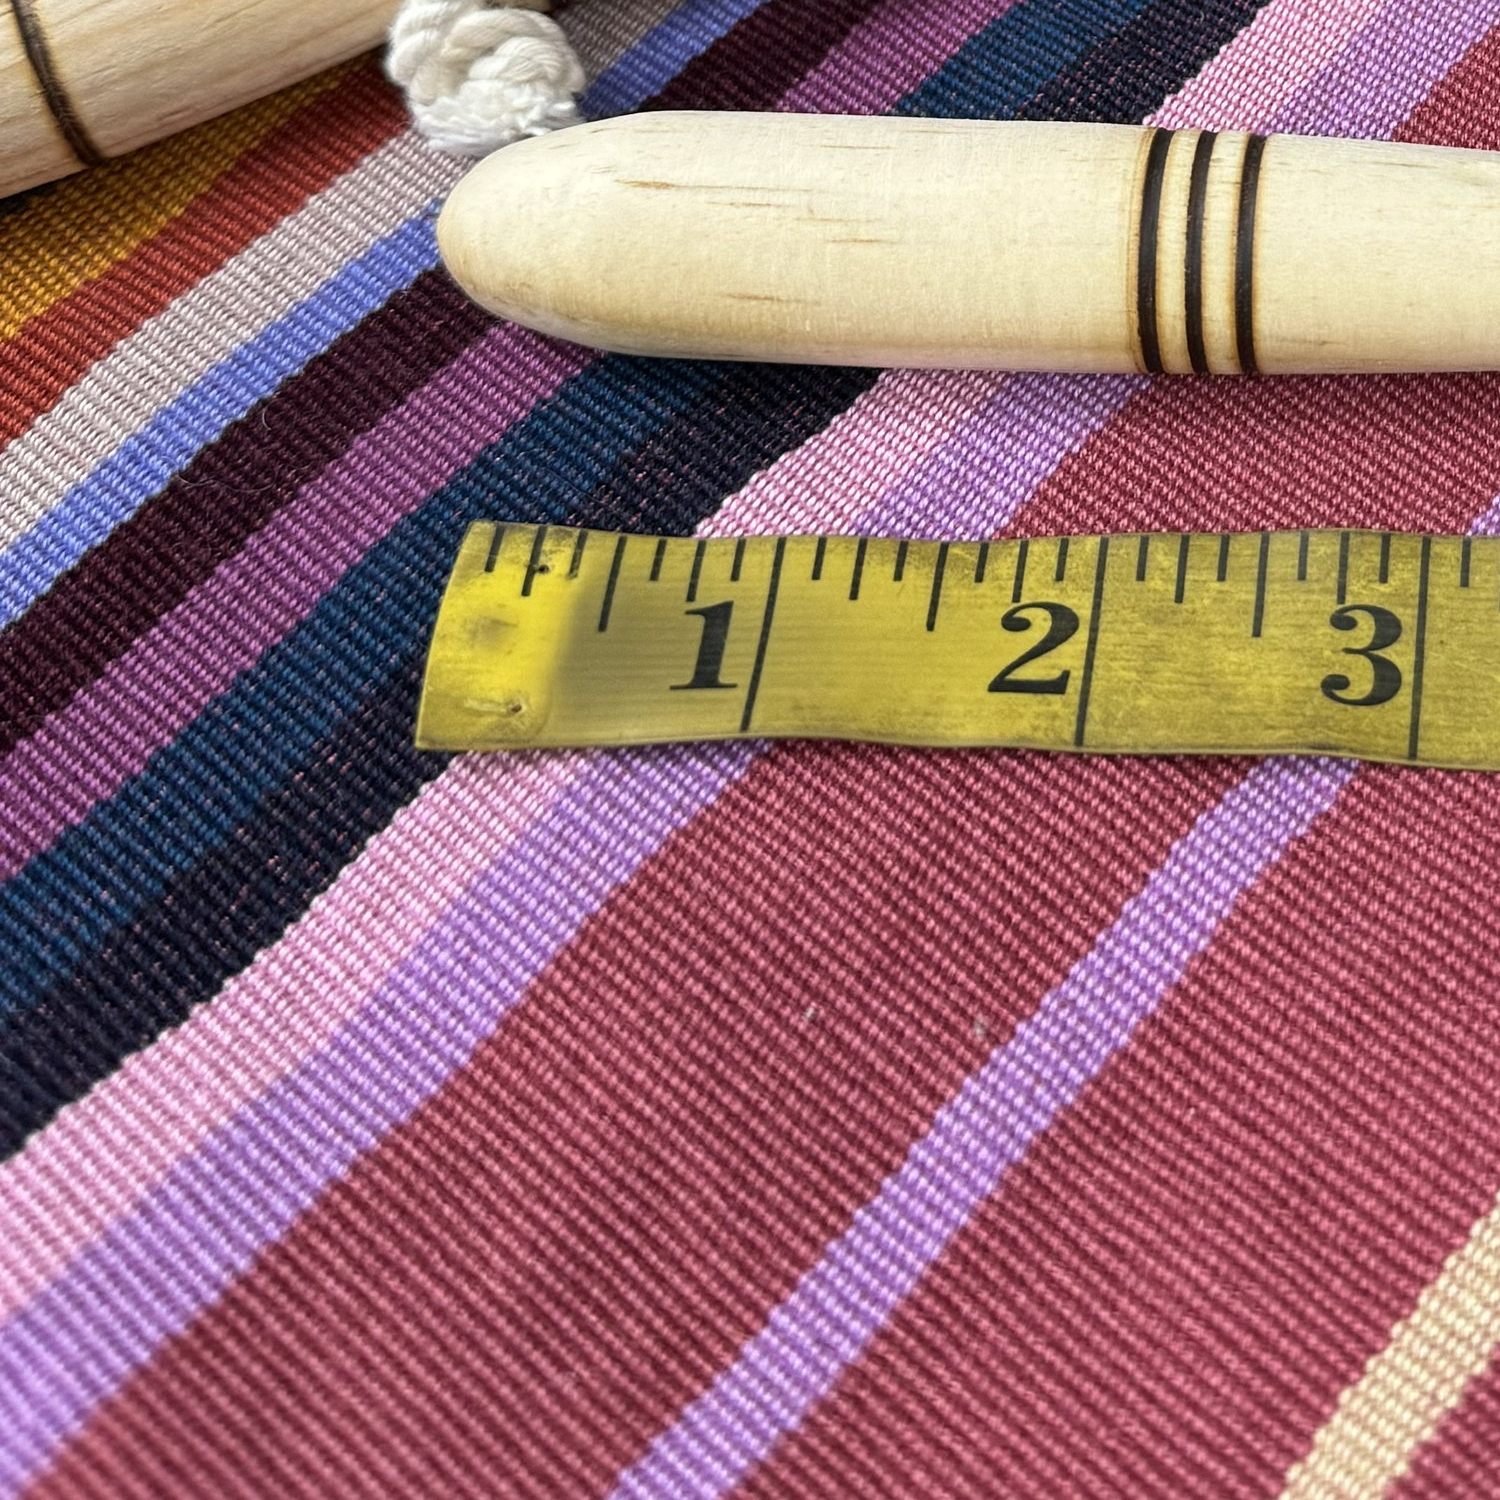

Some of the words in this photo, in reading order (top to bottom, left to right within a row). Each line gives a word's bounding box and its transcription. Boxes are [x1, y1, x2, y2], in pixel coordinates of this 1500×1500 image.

[670, 601, 738, 690] 1
[987, 601, 1080, 695] 2
[1321, 604, 1402, 706] 3
